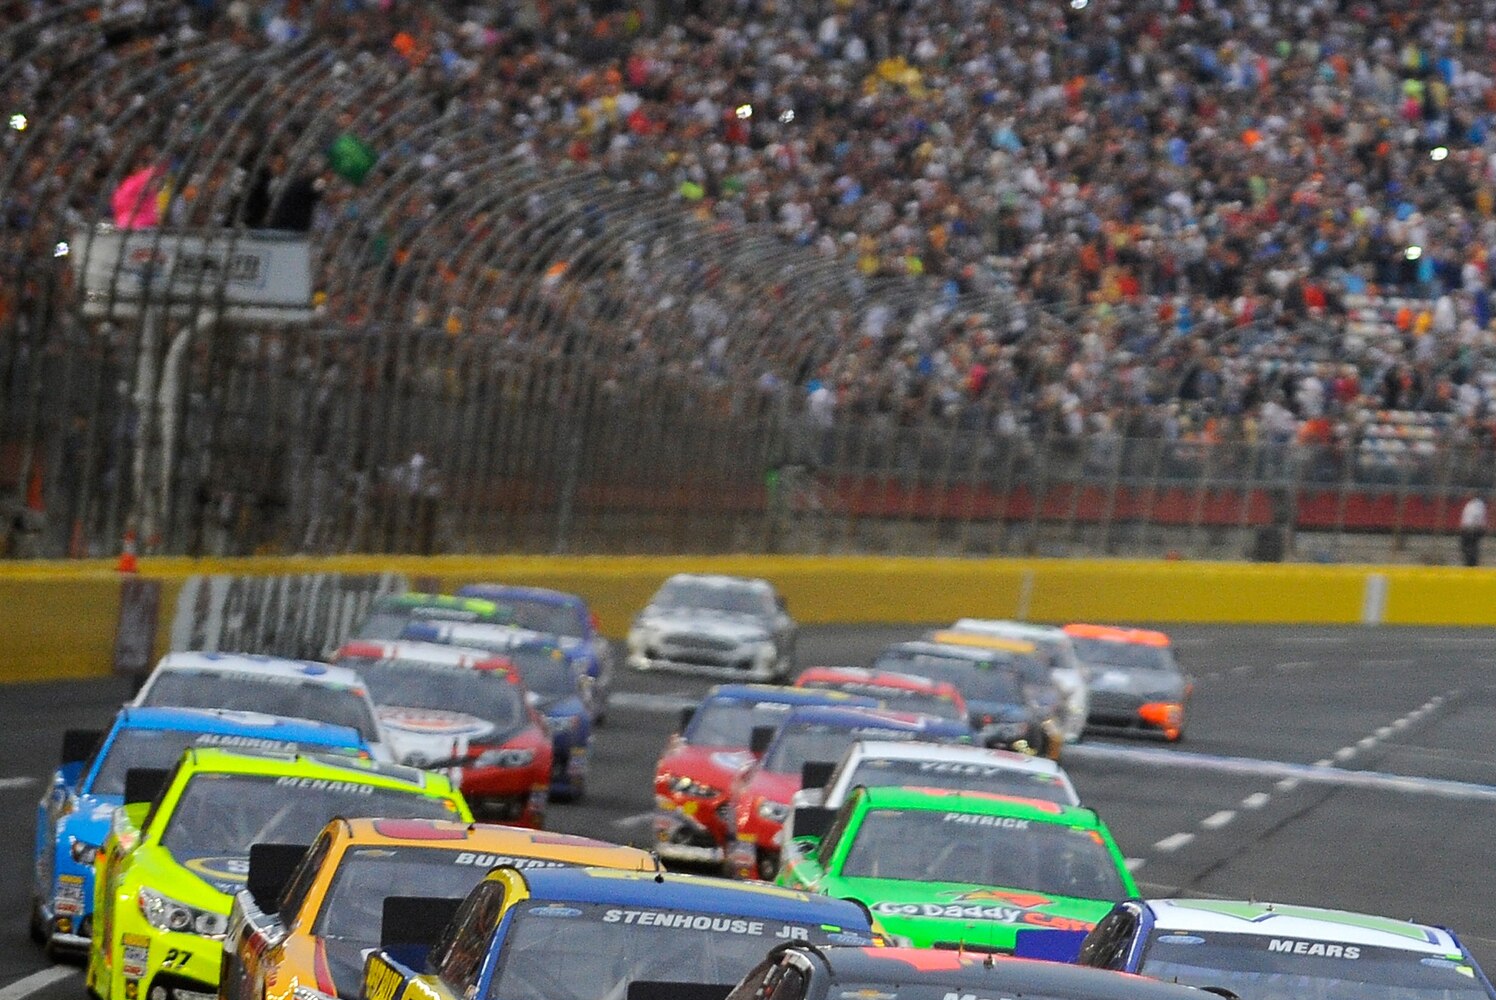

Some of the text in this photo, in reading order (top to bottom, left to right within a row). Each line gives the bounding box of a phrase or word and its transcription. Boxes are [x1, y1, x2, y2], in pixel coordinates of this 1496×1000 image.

[275, 776, 374, 794] MENARD
[944, 813, 1029, 829] PATRICK
[603, 909, 809, 940] STENHOUSE JR
[162, 948, 193, 968] 27
[1268, 939, 1361, 960] MEARS
